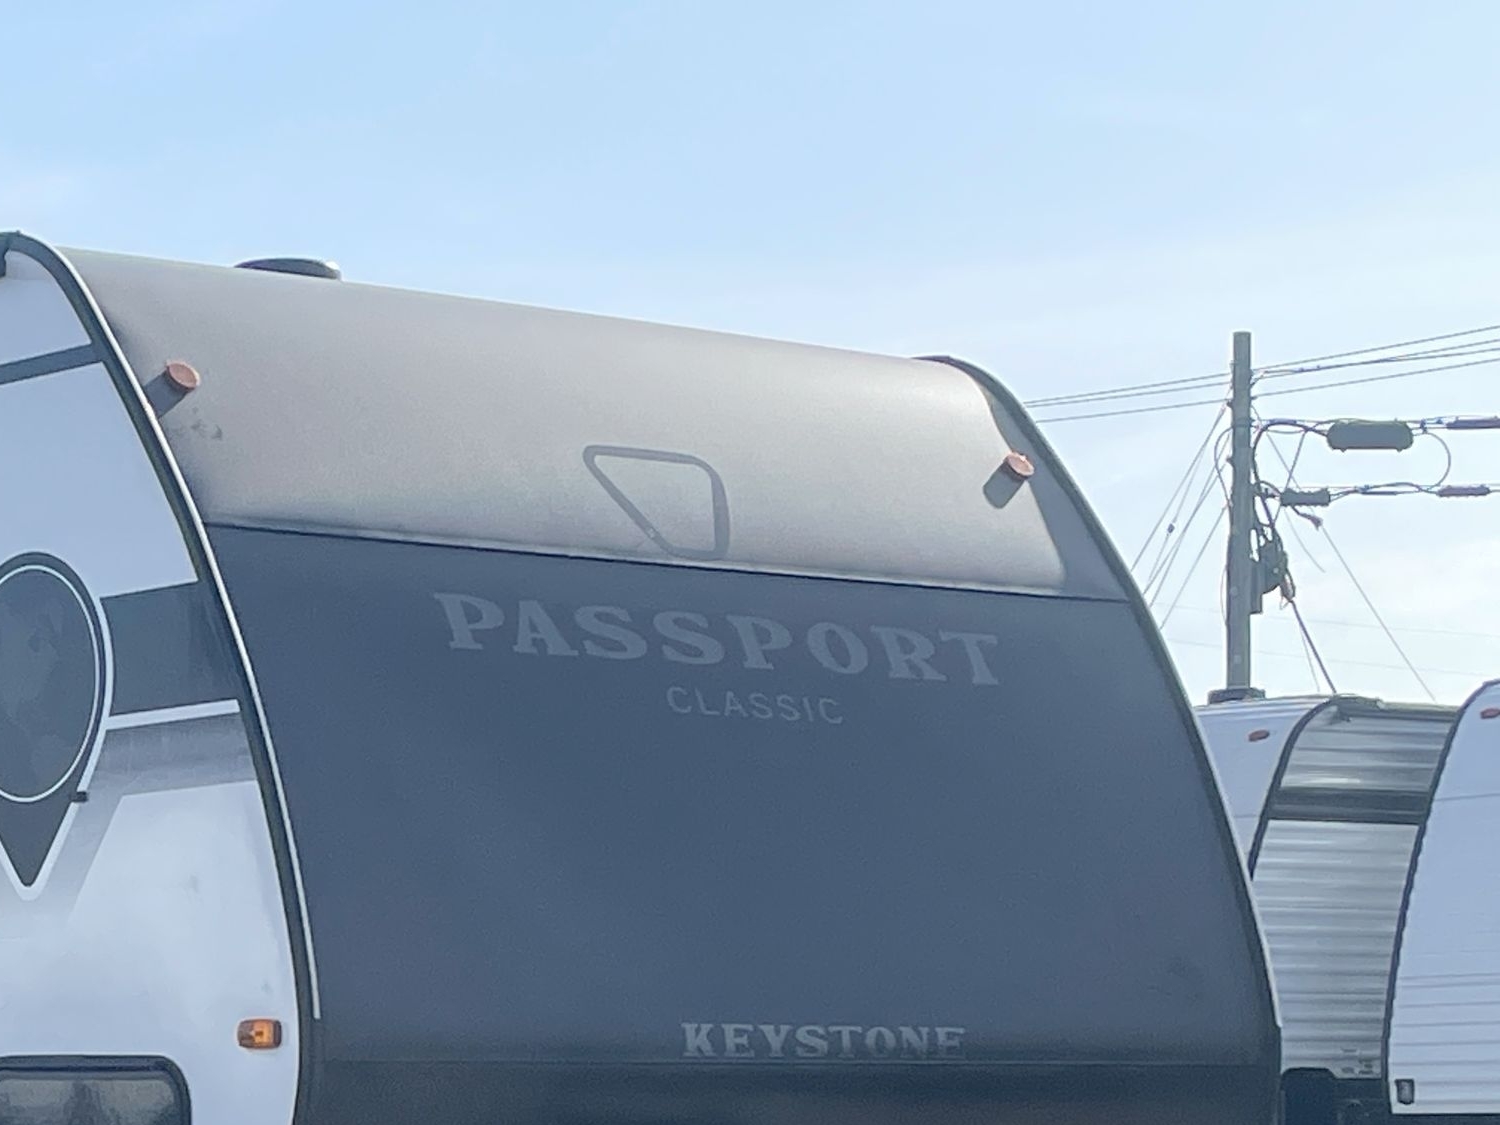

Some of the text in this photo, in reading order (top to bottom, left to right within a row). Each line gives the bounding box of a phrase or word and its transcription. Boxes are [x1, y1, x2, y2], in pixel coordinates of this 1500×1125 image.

[433, 592, 999, 685] PASSPORT
[666, 686, 844, 724] CLASSIC
[680, 1022, 966, 1058] KEYSTONE
